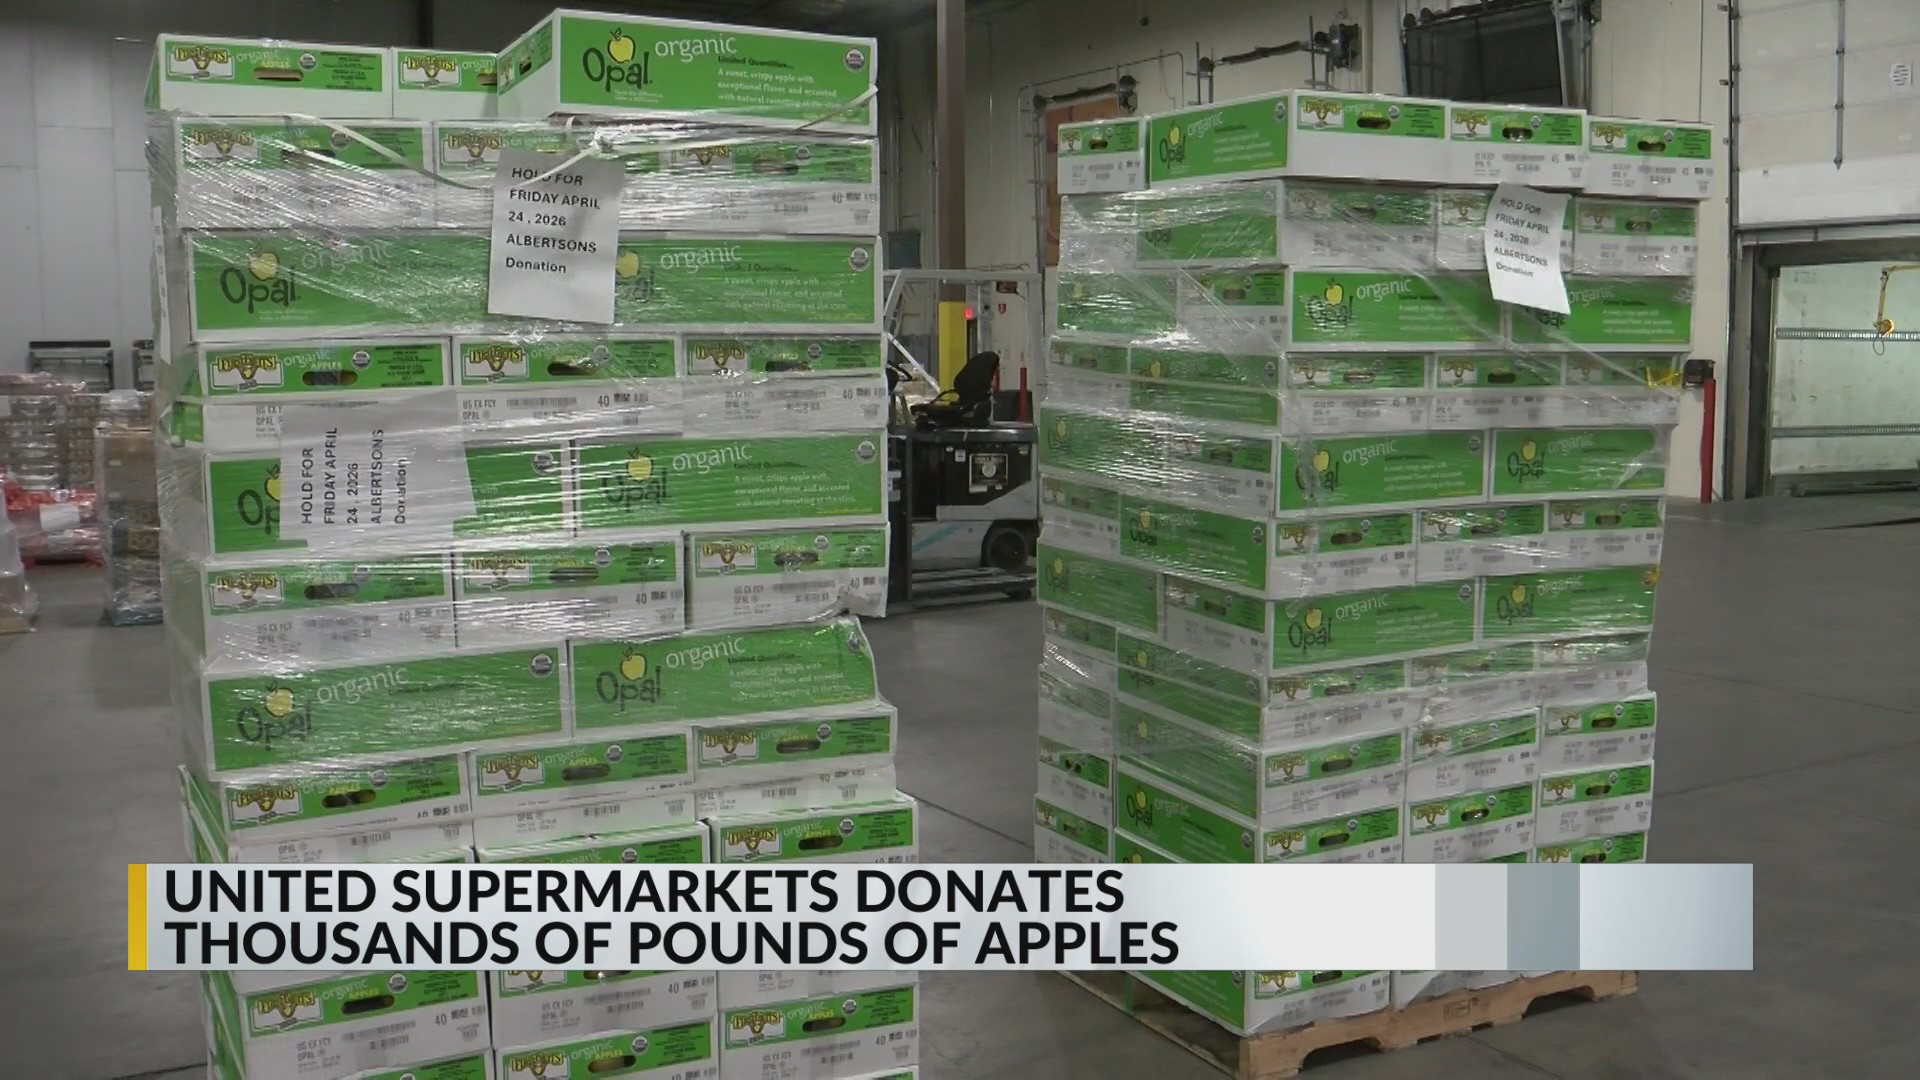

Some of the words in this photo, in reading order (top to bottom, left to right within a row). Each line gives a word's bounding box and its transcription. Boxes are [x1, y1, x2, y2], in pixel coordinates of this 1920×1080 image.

[655, 33, 738, 63] organic
[1187, 112, 1223, 137] organic
[1159, 134, 1186, 169] Opal
[555, 173, 584, 186] FOR
[509, 189, 559, 204] FRIDAY
[561, 195, 601, 210] APRIL
[1500, 198, 1523, 210] HOLD
[1523, 203, 1541, 215] FOR
[508, 210, 524, 223] 24
[534, 213, 567, 227] 2026
[1495, 213, 1526, 228] FRIDAY
[1526, 221, 1550, 234] APRIL
[506, 233, 597, 254] ALBERTSONS
[1493, 229, 1504, 238] 24
[301, 242, 397, 273] organic
[505, 257, 567, 274] Donation
[659, 241, 743, 274] organic
[1494, 245, 1548, 267] ALBERTSONS
[1496, 261, 1534, 277] Donation
[219, 267, 297, 314] Opal
[1356, 279, 1413, 303] organic
[310, 361, 342, 370] APPLES
[462, 400, 473, 410] US
[484, 399, 496, 409] FCY
[597, 395, 610, 408] 40
[462, 410, 480, 420] OPAL
[324, 427, 338, 470] APRIL
[671, 443, 753, 474] organic
[1343, 438, 1398, 466] organic
[301, 447, 314, 479] FOR
[346, 462, 359, 497] 2026
[370, 428, 384, 525] ALBERTSONS
[323, 472, 337, 525] FRIDAY
[394, 458, 407, 525] Donation
[236, 488, 280, 535] Op
[301, 481, 313, 525] HOLD
[346, 507, 359, 525] 24
[635, 593, 647, 605] 40
[1335, 592, 1390, 620] organic
[1287, 617, 1333, 654] Opal
[665, 636, 747, 669] organic
[316, 665, 408, 705] organic
[595, 665, 662, 712] Opal
[236, 700, 313, 752] Opal
[784, 822, 823, 839] organic
[321, 979, 368, 1001] organic
[349, 988, 380, 999] APPLES
[668, 982, 680, 994] 40
[434, 1013, 447, 1026] 40
[788, 1002, 825, 1020] organic
[571, 1039, 614, 1060] organic
[875, 1035, 886, 1046] 40
[594, 1049, 623, 1060] APPLES
